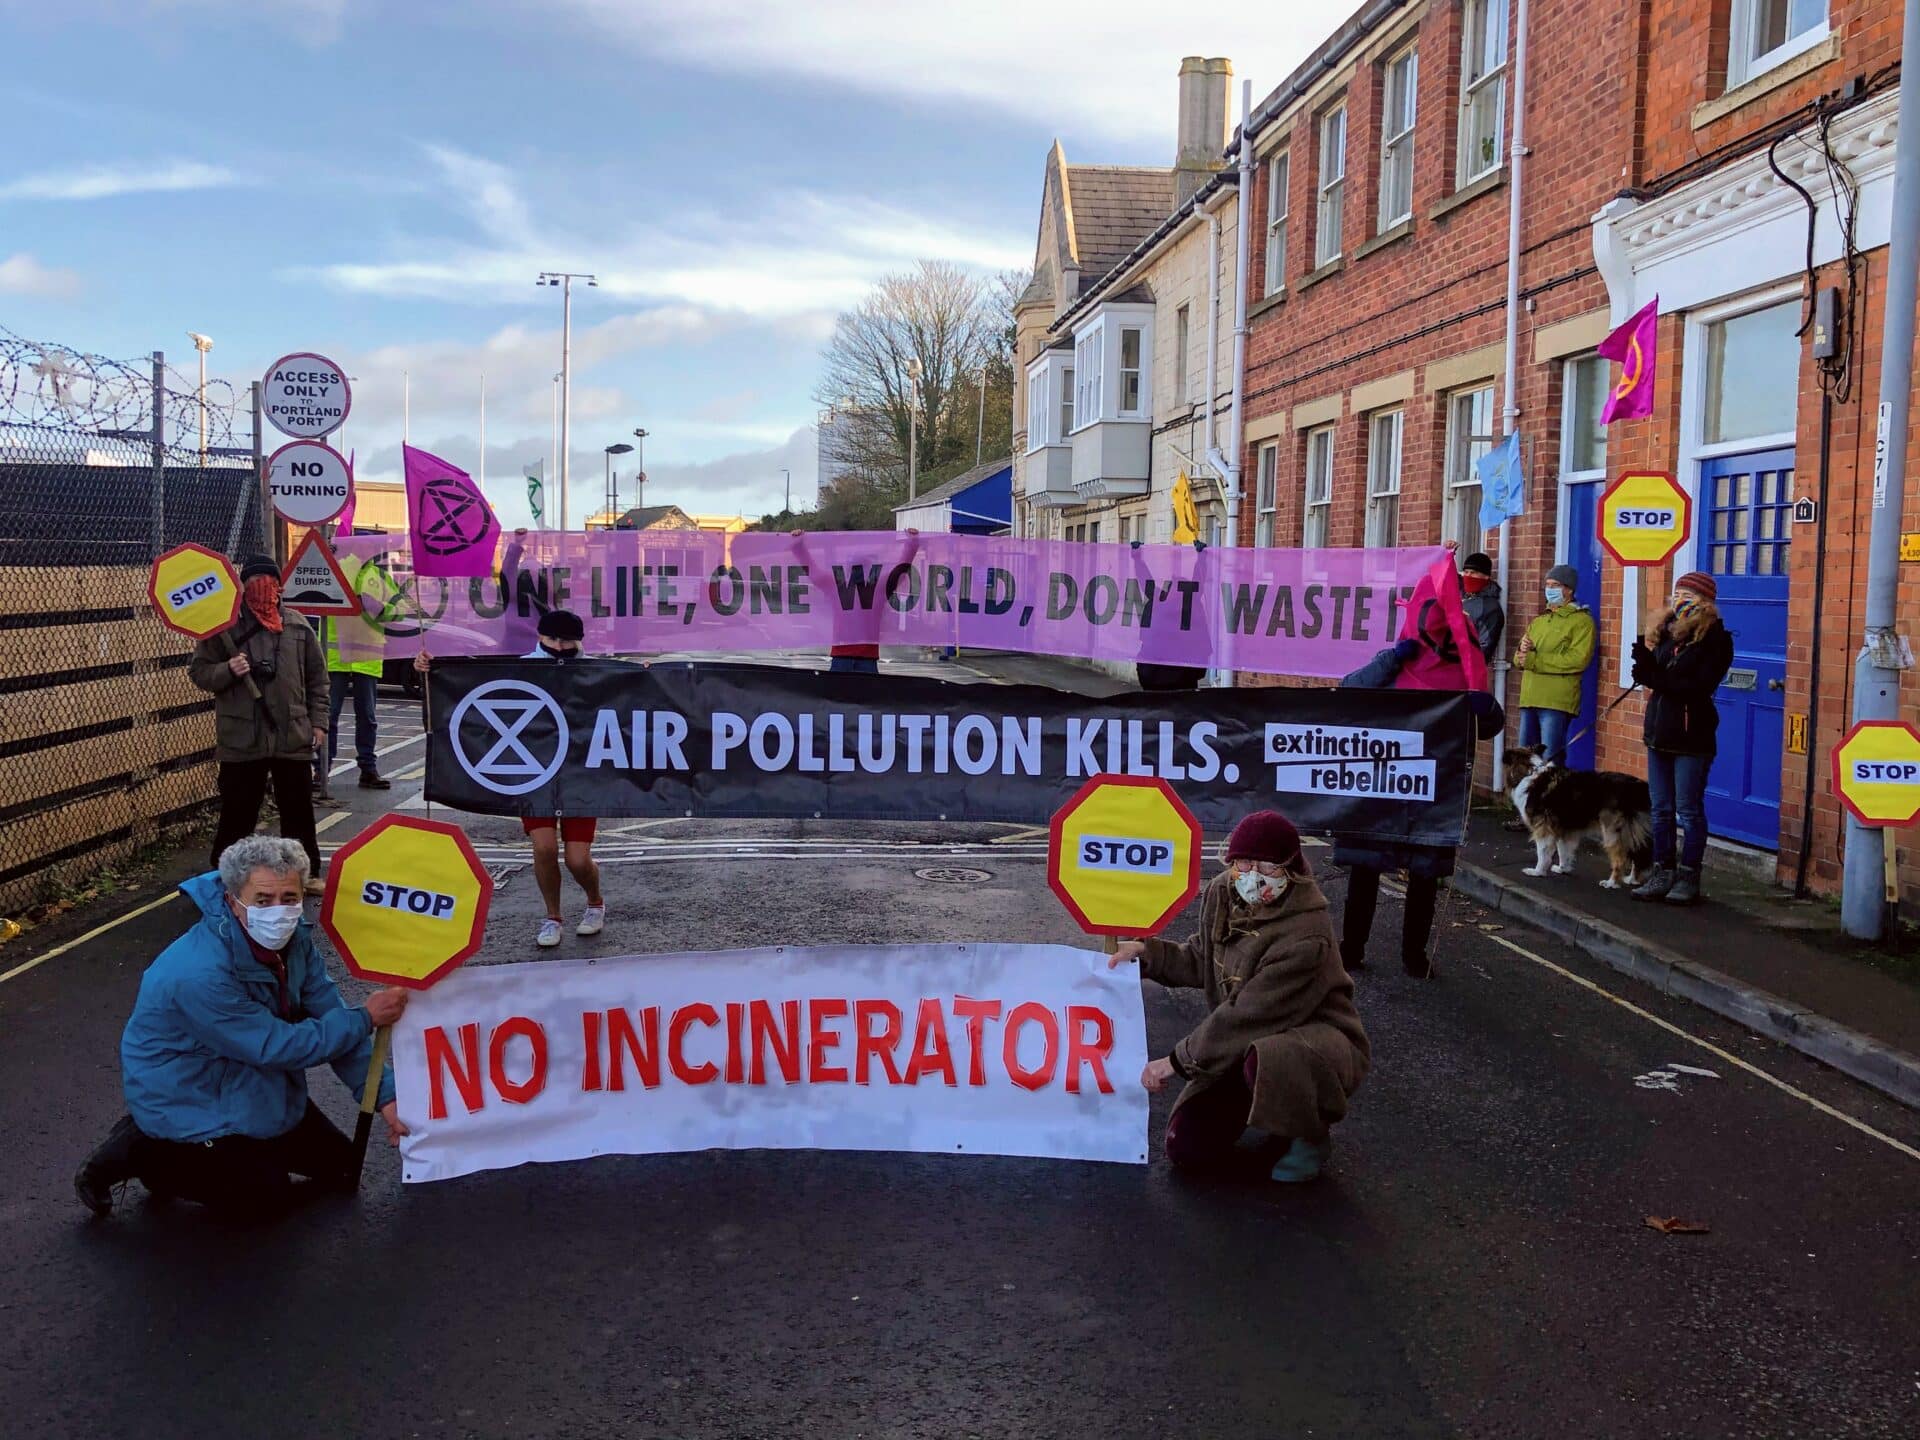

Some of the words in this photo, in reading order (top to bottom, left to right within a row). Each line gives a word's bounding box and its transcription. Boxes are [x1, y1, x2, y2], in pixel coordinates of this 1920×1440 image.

[273, 370, 340, 384] ACCESS
[283, 384, 329, 397] ONLY
[300, 398, 313, 406] TO
[271, 405, 342, 417] PORTLAND
[287, 416, 325, 426] PORT
[291, 462, 324, 477] NO
[270, 485, 347, 496] TURNING
[1618, 511, 1672, 526] STOP
[295, 566, 331, 576] SPEED
[294, 577, 332, 586] BUMPS
[171, 576, 217, 606] STOP
[468, 565, 571, 618] ONE
[591, 565, 696, 625] LIFE,
[709, 564, 811, 616] ONE
[832, 562, 1034, 627] WORLD,
[1046, 572, 1200, 631] DON'T
[1221, 582, 1372, 642] WASTE
[585, 709, 690, 771] AIR
[711, 711, 1042, 777] POLLUTION
[1066, 718, 1241, 784] KILLS.
[1272, 728, 1402, 760] extinction
[1311, 757, 1430, 796] rebellion
[1857, 764, 1917, 779] STOP
[1083, 841, 1170, 867] STOP
[362, 881, 455, 917] STOP
[424, 1015, 549, 1120] NO
[582, 994, 1115, 1095] INCINERATOR
